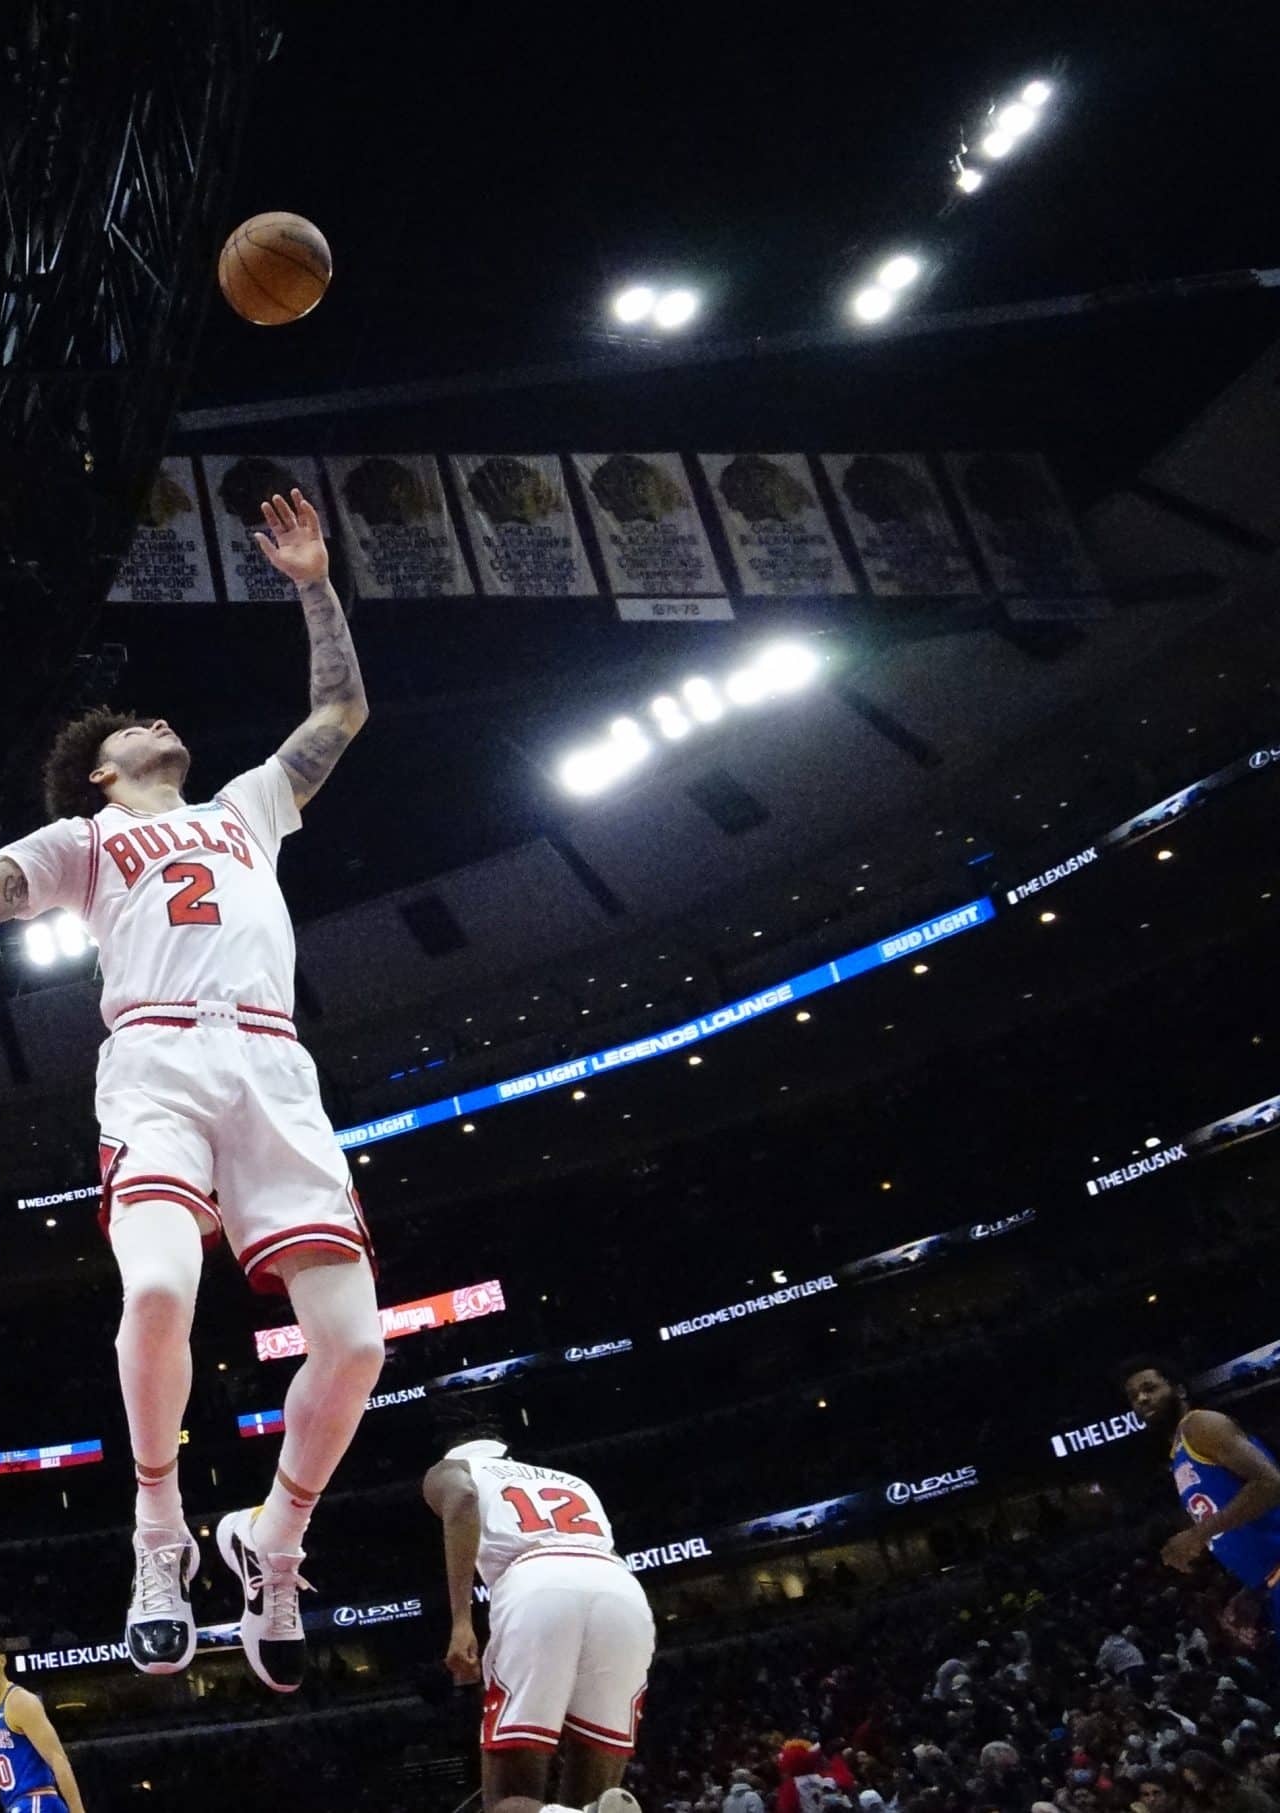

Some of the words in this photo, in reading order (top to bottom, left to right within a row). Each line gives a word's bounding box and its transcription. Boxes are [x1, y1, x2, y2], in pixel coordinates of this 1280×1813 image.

[103, 821, 254, 889] BULLS
[1017, 878, 1040, 899] THE
[1039, 858, 1080, 887] LEXUS
[1076, 847, 1098, 869] NX
[162, 862, 221, 926] 2
[882, 932, 921, 958] BUD
[920, 906, 980, 943] LIGHT
[592, 1023, 700, 1070] LEGENDS
[699, 985, 794, 1035] LOUNGE
[499, 1078, 536, 1099] BUD
[535, 1060, 589, 1090] LIGHT
[368, 1114, 415, 1140] LIGHT
[1097, 1170, 1123, 1190] THE
[1122, 1155, 1165, 1182] LEXUS
[1162, 1144, 1188, 1165] NX
[26, 1191, 74, 1208] WELCOME
[74, 1188, 87, 1199] TO
[669, 1308, 730, 1337] WELCOME
[727, 1304, 746, 1319] TO
[745, 1294, 770, 1313] THE
[768, 1285, 801, 1306] NEXT
[799, 1274, 838, 1296] LEVEL
[584, 1338, 632, 1356] LEXUS
[372, 1391, 408, 1410] LEXUS
[406, 1386, 426, 1400] NX
[1065, 1424, 1104, 1452] THE
[910, 1465, 976, 1494] LEXUS
[501, 1486, 605, 1537] 12
[663, 1538, 712, 1564] LEVEL
[357, 1599, 421, 1618] LEXUS
[28, 1651, 58, 1671] THE
[58, 1645, 109, 1667] LEXUS
